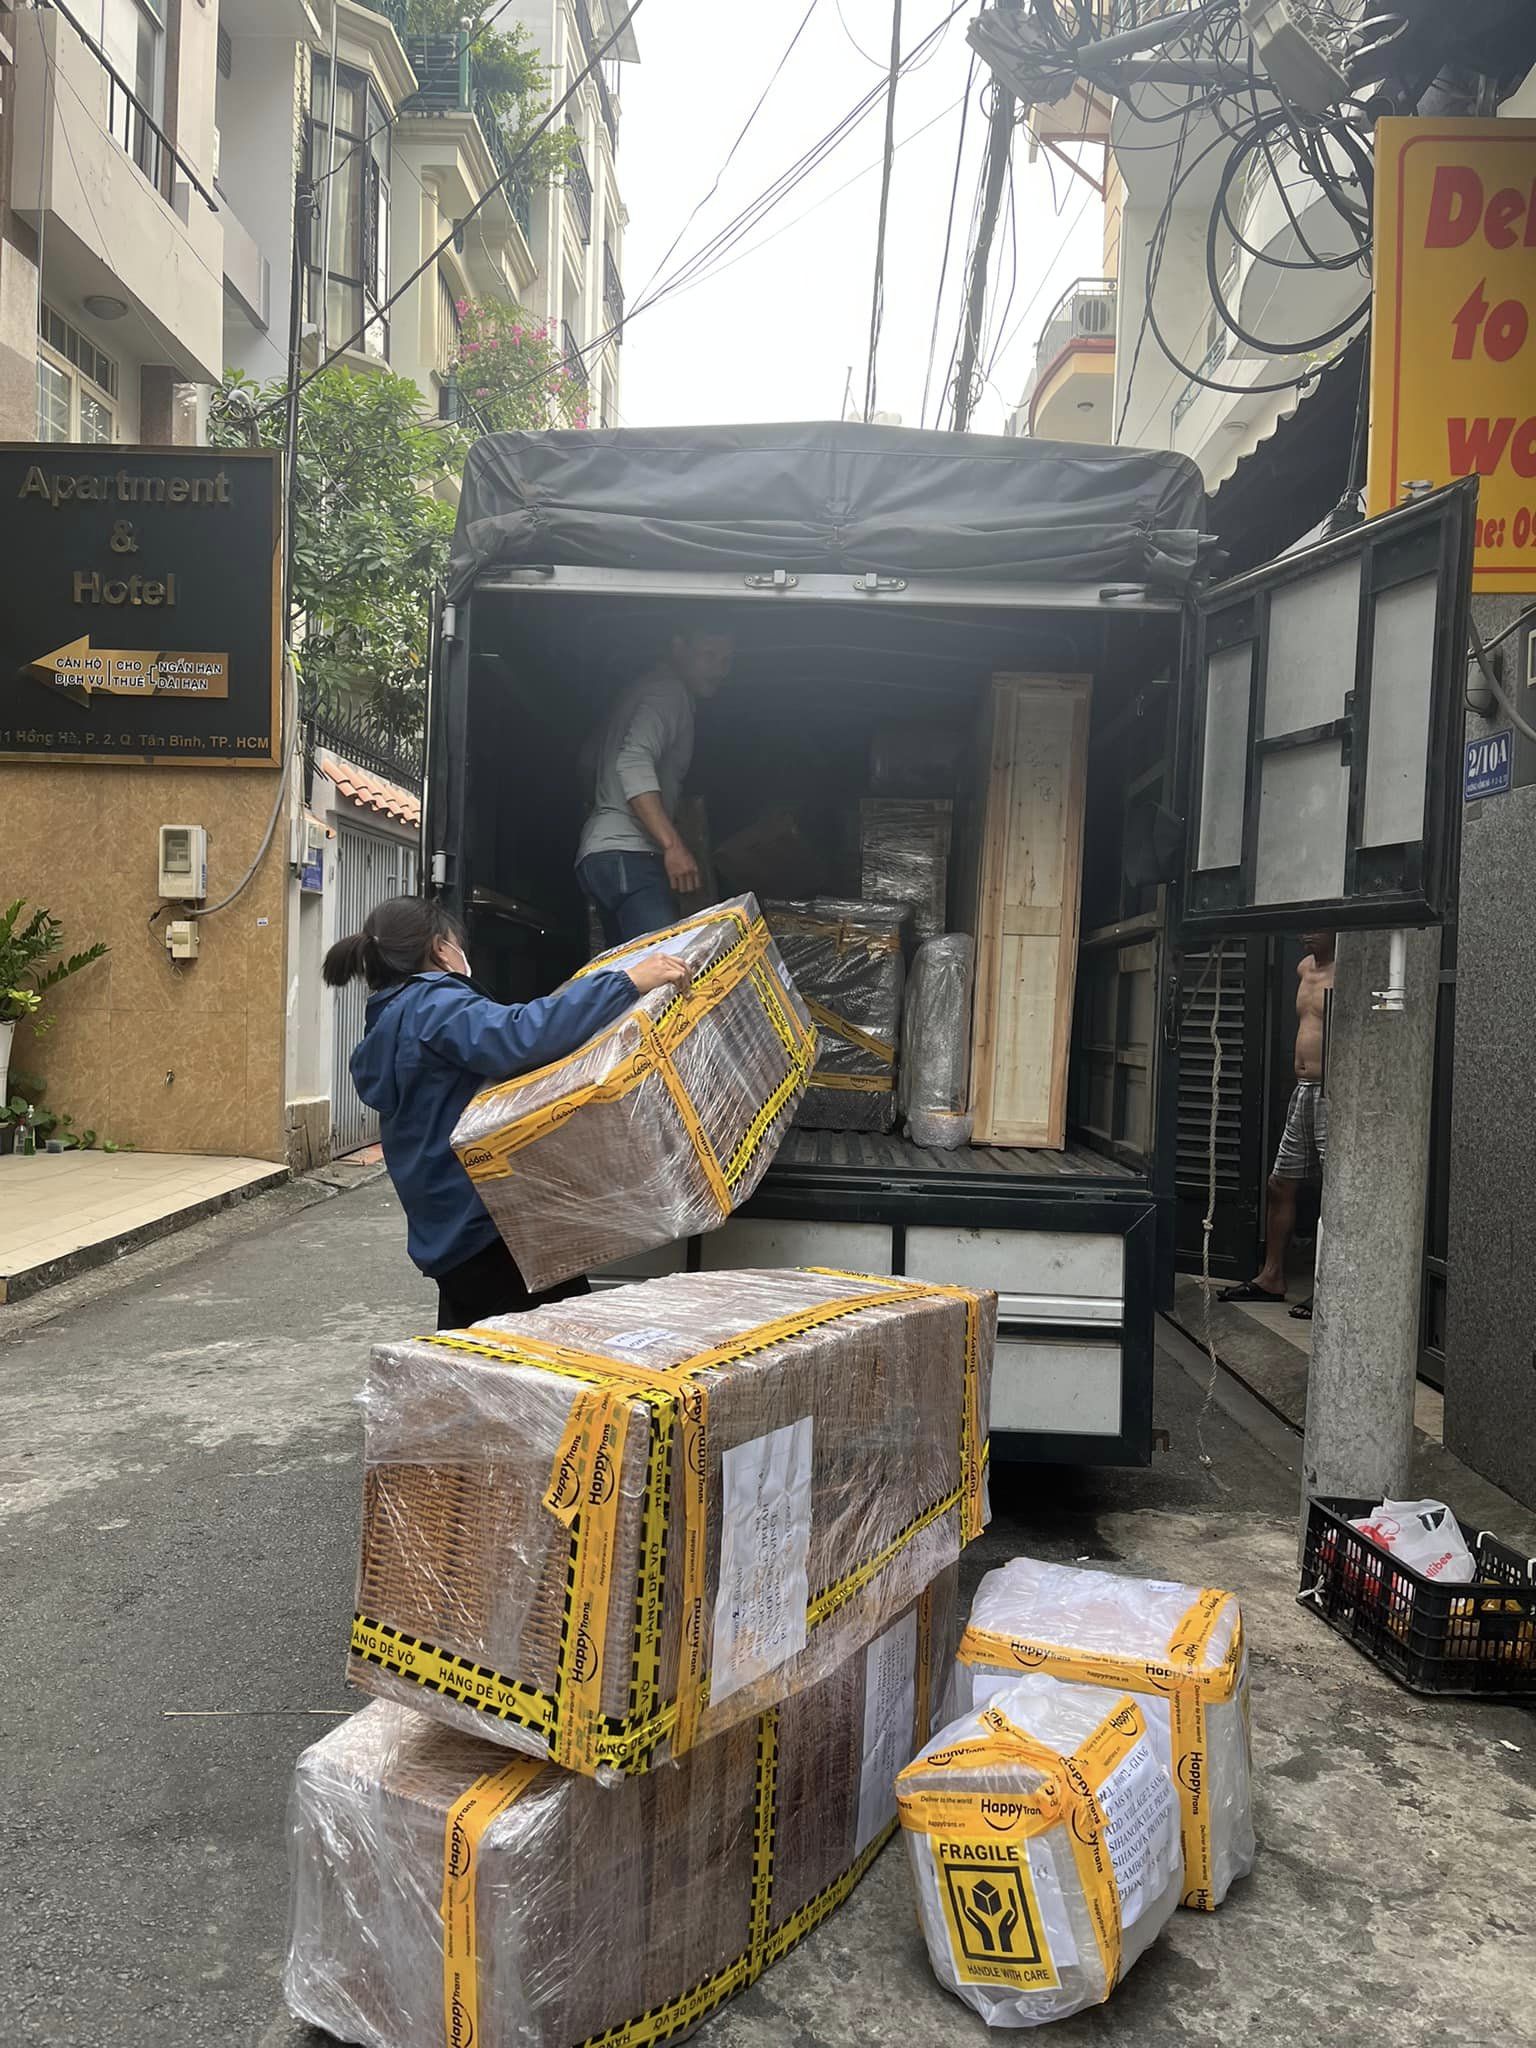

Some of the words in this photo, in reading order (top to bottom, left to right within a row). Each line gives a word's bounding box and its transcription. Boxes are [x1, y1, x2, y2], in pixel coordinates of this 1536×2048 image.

[1451, 277, 1529, 362] to
[17, 465, 232, 508] Apartment
[110, 519, 139, 552] &
[72, 570, 176, 606] Hotel
[116, 661, 142, 671] CHO
[236, 736, 269, 749] HCM
[1468, 739, 1507, 778] 2/10A
[549, 1435, 582, 1509] HappyTrans
[589, 1424, 612, 1506] HappyTrans
[1425, 1552, 1453, 1578] llibee
[352, 1629, 376, 1650] ÀNG
[572, 1601, 591, 1684] HappyTrans
[439, 1666, 473, 1692] HÀNG
[1188, 1751, 1204, 1816] HappyTrans
[981, 1798, 1042, 1819] HappyTran
[448, 1799, 477, 1878] HappyTrans
[939, 1843, 1019, 1861] FRAGILE
[968, 1965, 1001, 1979] HANDLE
[1001, 1967, 1022, 1982] WITH
[1024, 1968, 1050, 1982] CARE
[450, 1972, 465, 2048] HappyTrans
